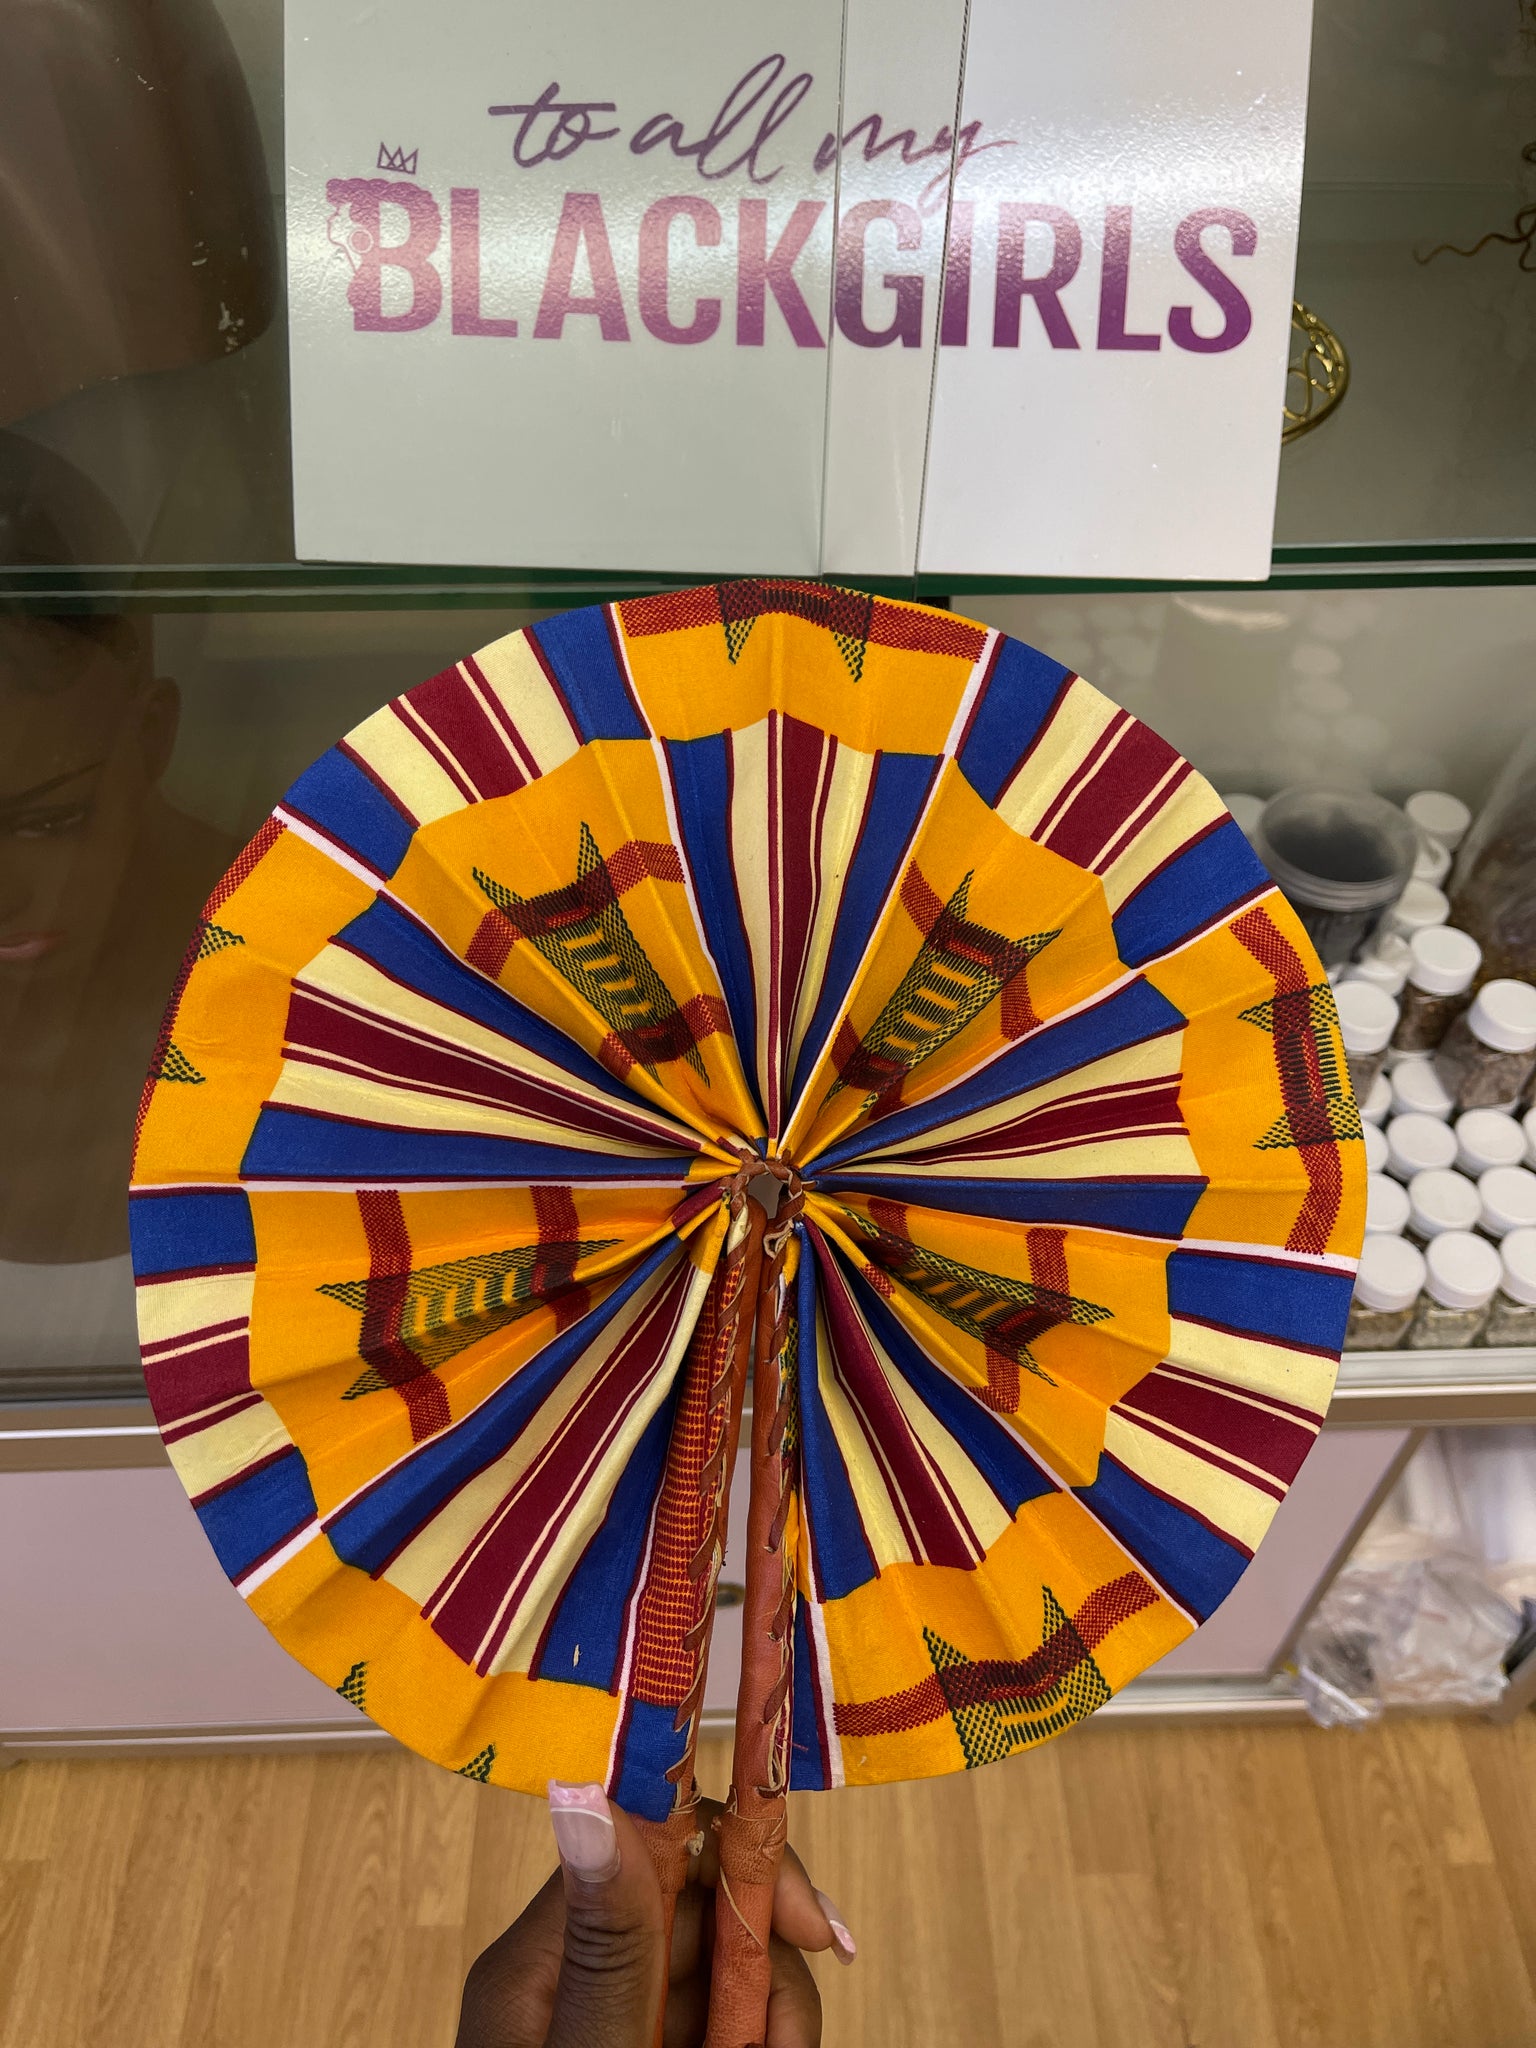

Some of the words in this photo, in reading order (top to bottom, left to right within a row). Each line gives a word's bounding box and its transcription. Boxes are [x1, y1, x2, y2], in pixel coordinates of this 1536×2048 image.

[488, 82, 620, 167] to
[630, 53, 813, 184] all
[813, 112, 1018, 216] my
